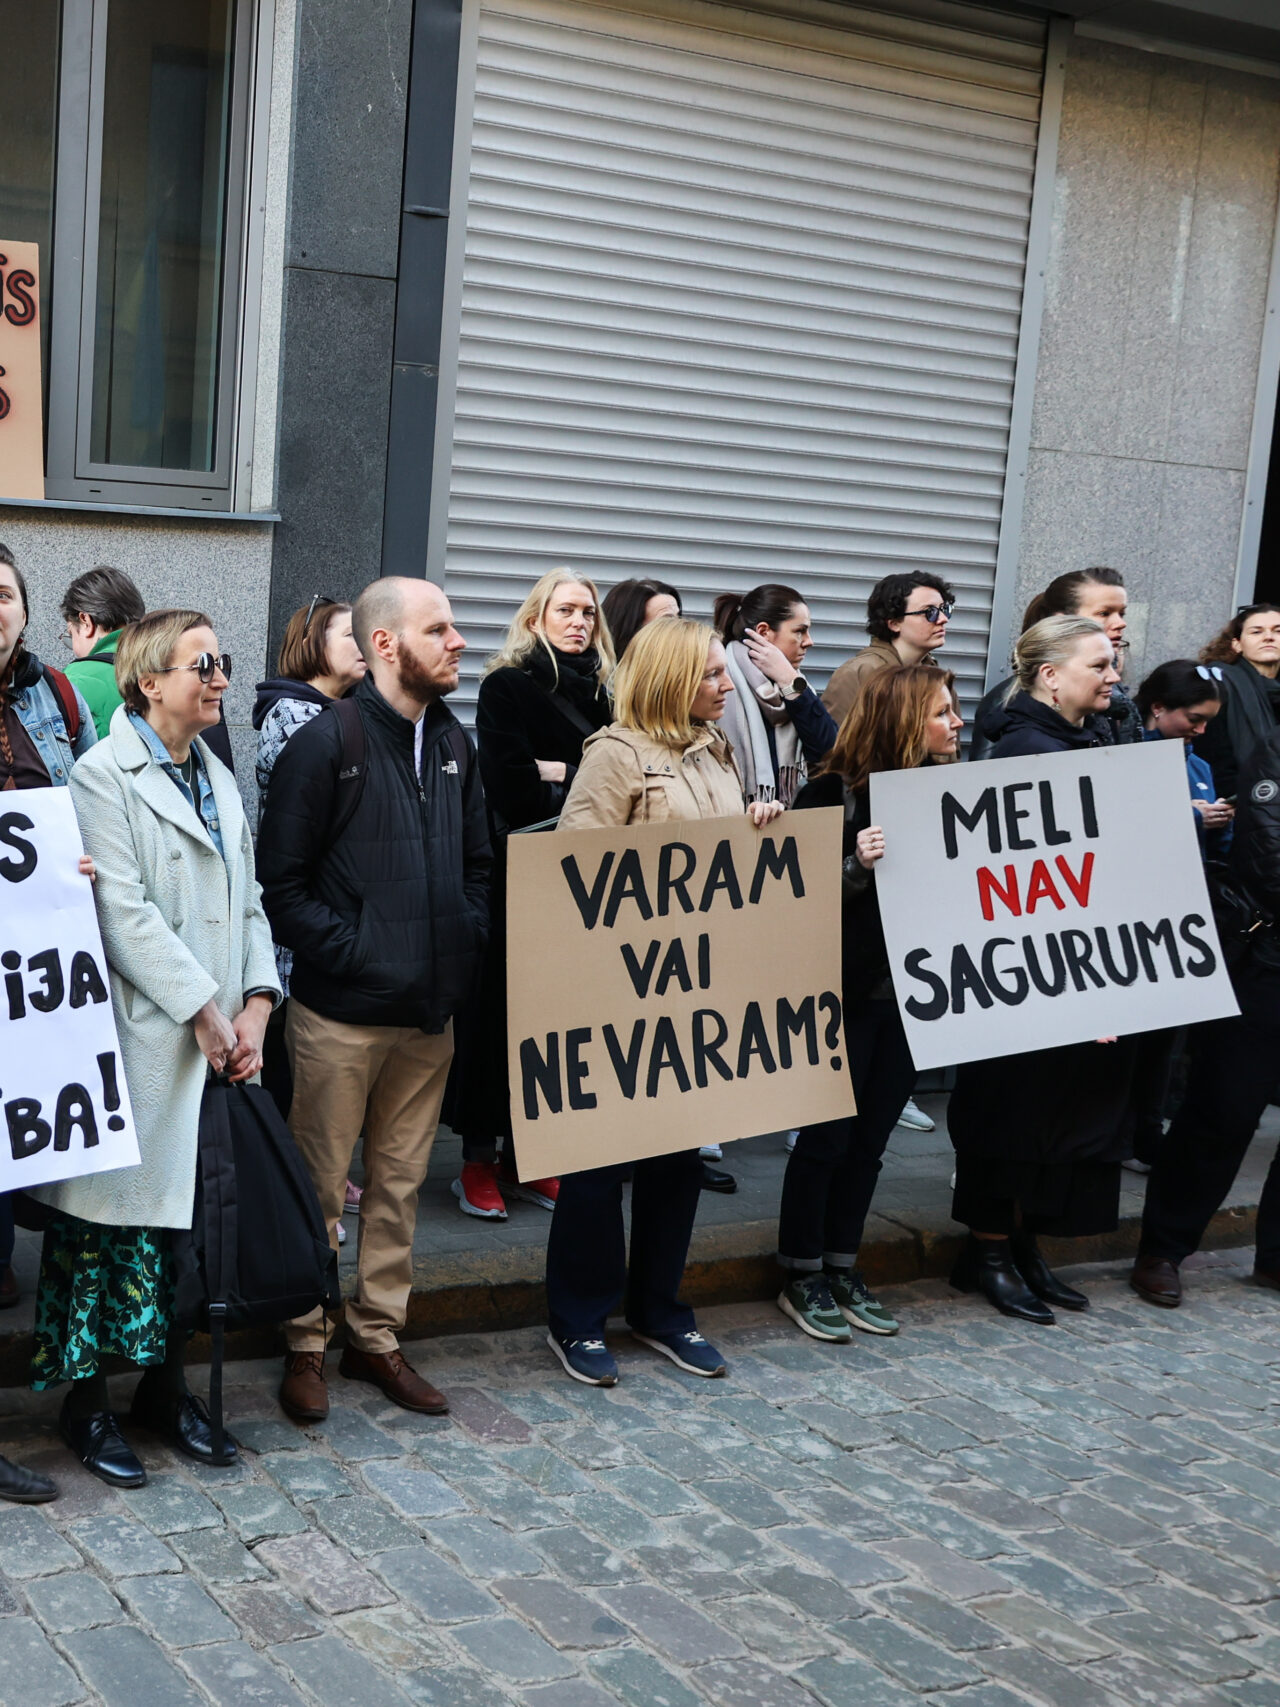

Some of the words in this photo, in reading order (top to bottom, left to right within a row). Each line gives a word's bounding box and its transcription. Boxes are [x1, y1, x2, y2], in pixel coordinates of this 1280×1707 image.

[941, 775, 1099, 859] MELI
[560, 836, 806, 930] VARAM
[976, 852, 1095, 921] NAV
[619, 933, 711, 999] VAI
[903, 913, 1216, 1021] SAGURUMS
[519, 991, 843, 1121] NEVARAM?
